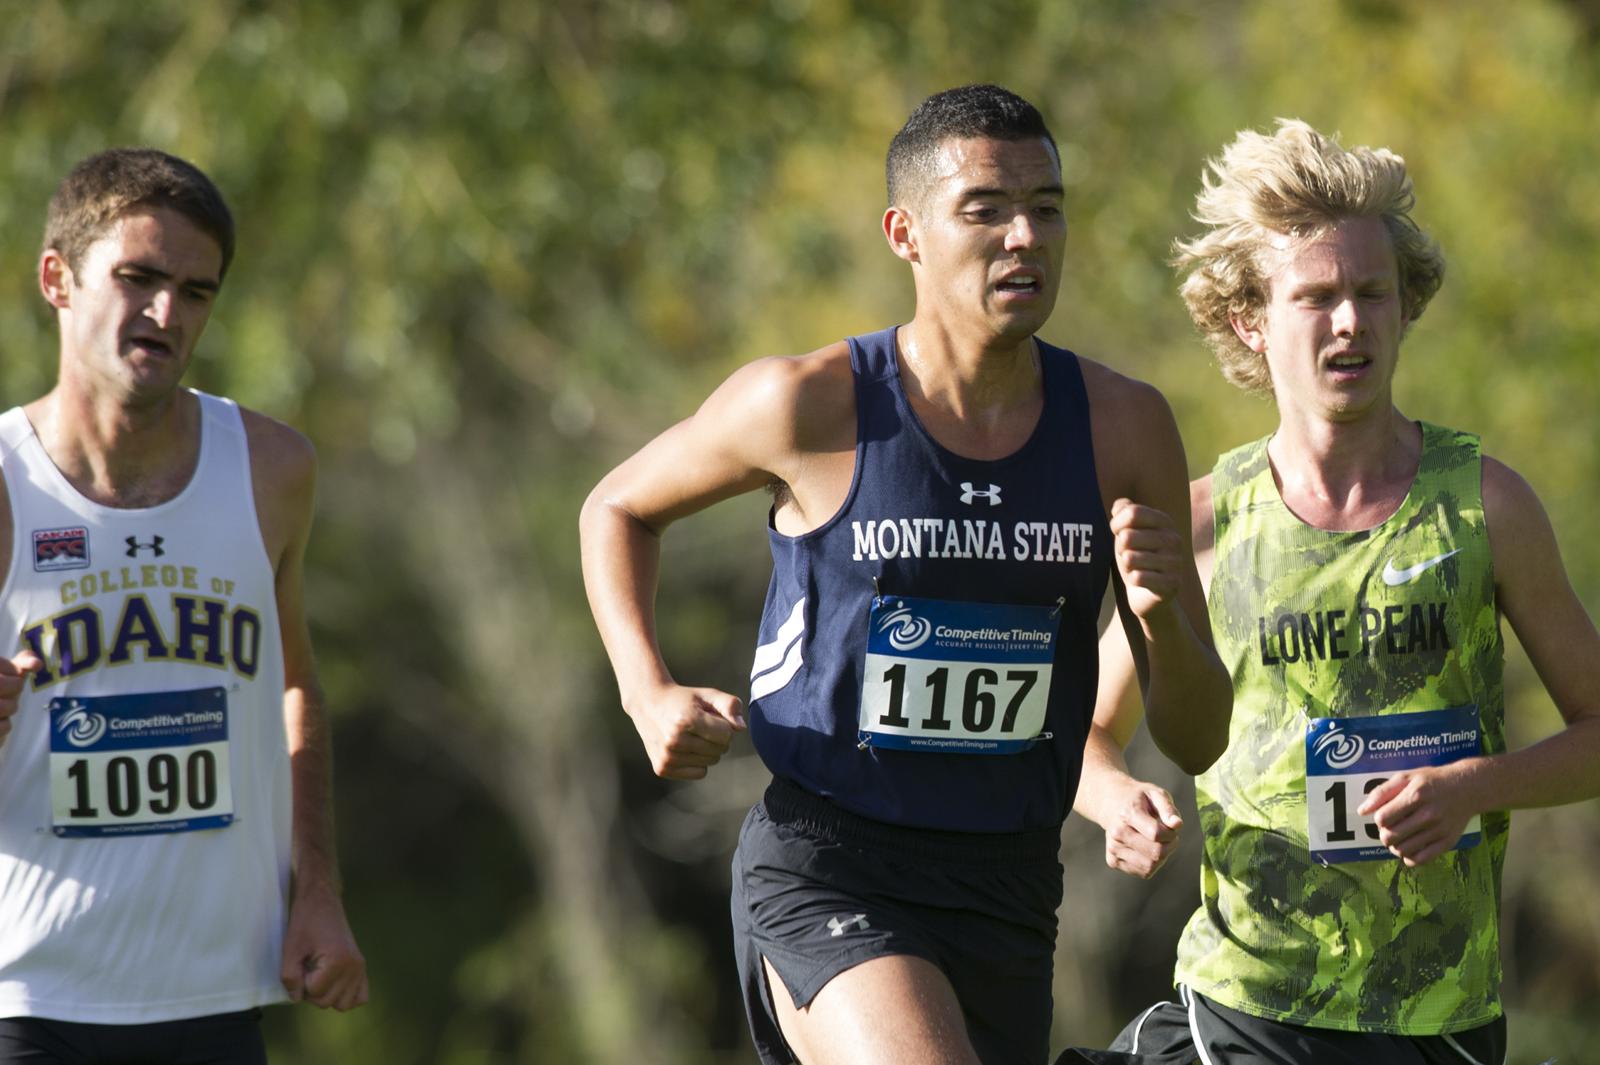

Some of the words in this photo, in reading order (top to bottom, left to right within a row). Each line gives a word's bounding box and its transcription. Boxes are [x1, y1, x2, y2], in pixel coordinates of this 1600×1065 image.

[852, 518, 1006, 561] MONTANA
[1014, 521, 1093, 563] STATE
[60, 564, 200, 604] COLLEGE
[211, 577, 235, 597] OF
[21, 593, 262, 692] IDAHO
[1259, 609, 1349, 666] LONE
[1359, 602, 1450, 656] PEAK
[879, 663, 1038, 733] 1167
[911, 739, 998, 749] www.CompetitiveTiming.com
[68, 750, 217, 818] 1090
